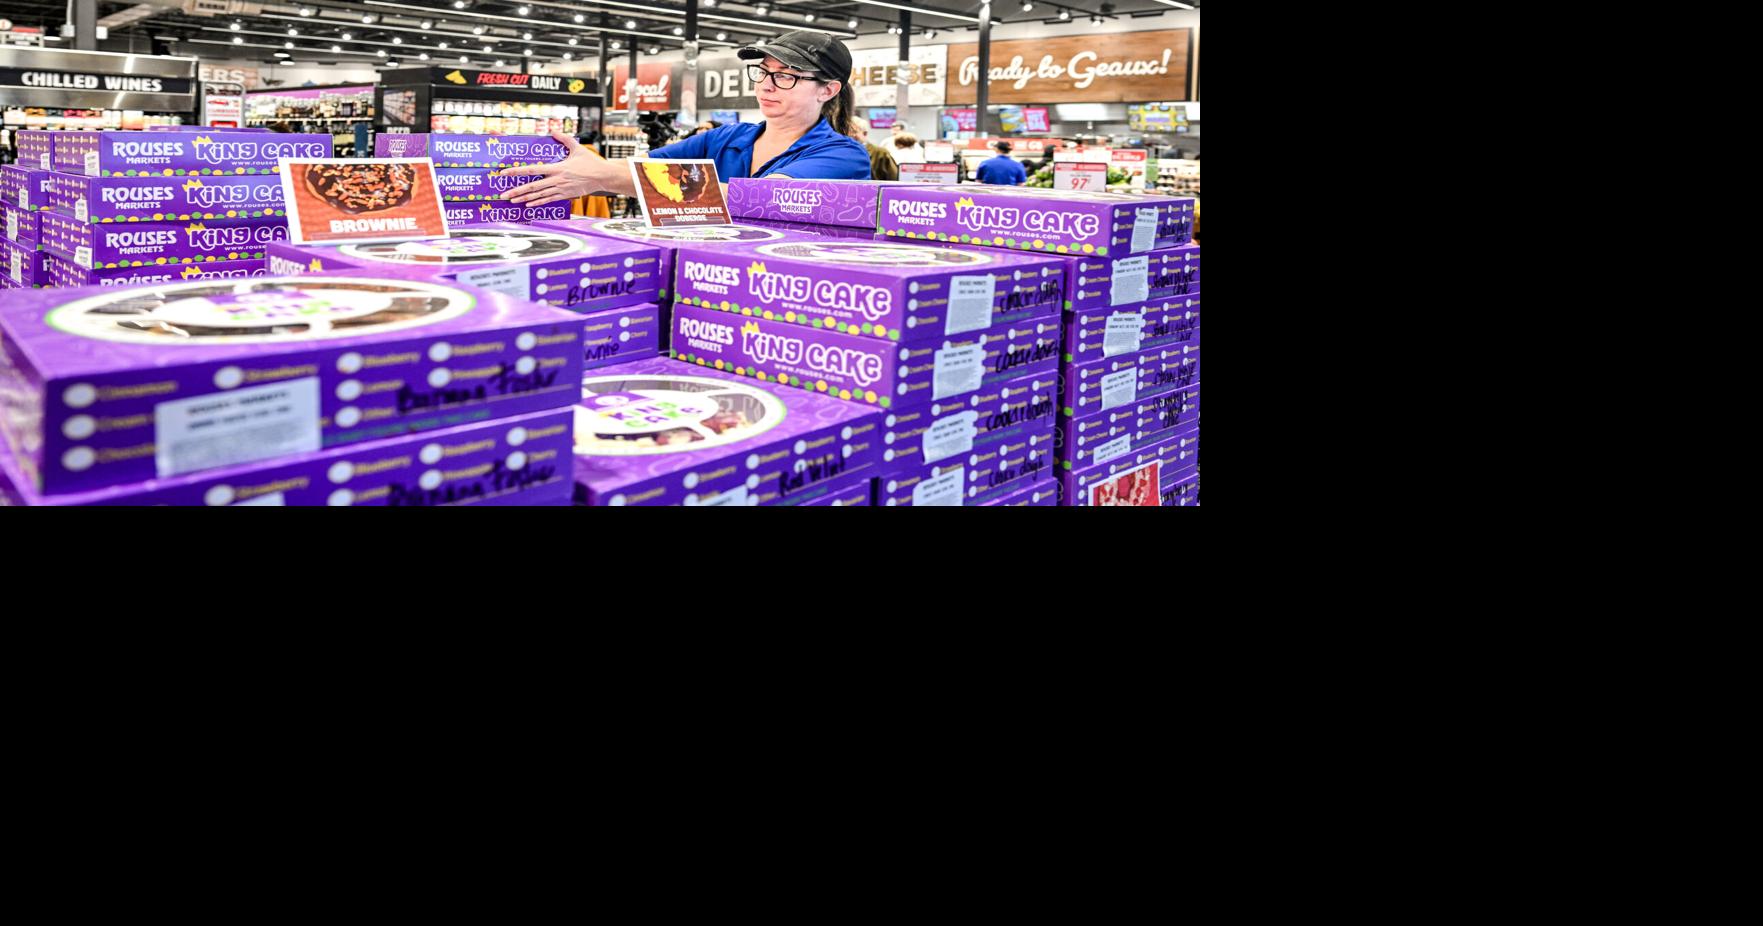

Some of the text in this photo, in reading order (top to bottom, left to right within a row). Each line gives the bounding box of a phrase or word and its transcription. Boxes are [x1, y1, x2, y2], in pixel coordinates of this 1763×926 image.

[198, 68, 245, 83] ERS
[851, 63, 937, 86] HEESE
[1038, 55, 1066, 79] to
[1067, 48, 1172, 88] Geaux!
[21, 72, 163, 92] CHILLED WINES
[477, 73, 561, 90] FRESH CUT DAILY
[704, 69, 757, 97] DEL
[112, 141, 184, 157] ROUSES
[435, 141, 481, 153] ROUSES
[438, 175, 482, 186] ROUSES
[102, 186, 175, 202] ROUSES
[253, 184, 285, 202] CA
[772, 187, 823, 206] ROUSES
[115, 202, 161, 210] MARKETS
[652, 207, 678, 215] LEMON
[685, 206, 723, 215] CHOCOLATE
[781, 203, 812, 214] MARKETS
[888, 198, 948, 219] ROUSES
[446, 209, 473, 220] USES
[898, 215, 935, 226] MARKETS
[329, 217, 418, 233] BROWNIE
[106, 231, 177, 247] ROUSES
[254, 226, 290, 244] CA
[990, 228, 1061, 241] www.rouses.com
[118, 246, 164, 255] MARKETS
[684, 261, 740, 286] ROUSES
[693, 281, 729, 295] MARKETS
[781, 301, 853, 318] www.rouses.com
[680, 317, 734, 345] ROUSES
[688, 339, 723, 353] MARKETS
[774, 363, 844, 383] www.rouses.com
